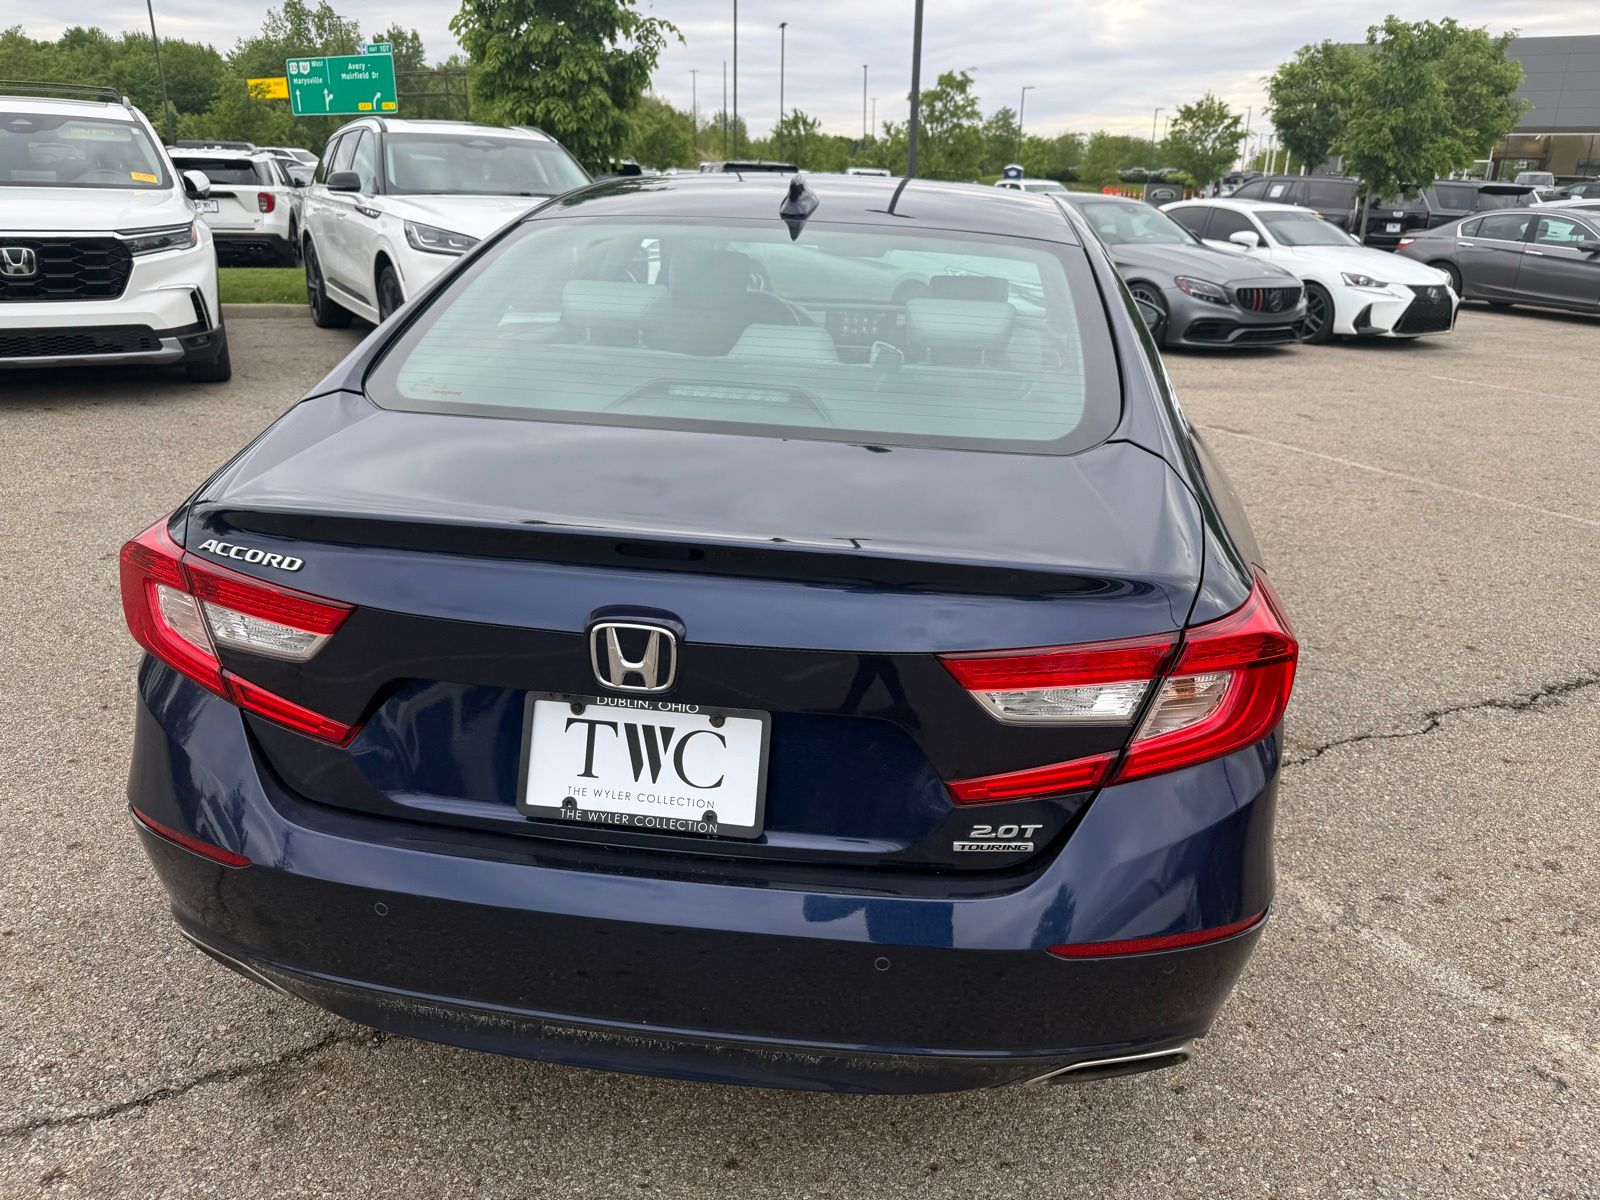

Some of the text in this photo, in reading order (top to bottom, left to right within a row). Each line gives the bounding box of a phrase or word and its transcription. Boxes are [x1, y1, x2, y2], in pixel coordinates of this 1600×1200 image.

[347, 63, 366, 71] Avery
[293, 77, 323, 85] Marysville
[341, 71, 379, 80] Muirfield Dr
[198, 539, 304, 571] ACCORD
[658, 702, 699, 714] OHIO
[564, 717, 727, 789] TWC
[567, 786, 715, 809] THE WYLER COLLECTION
[560, 808, 718, 833] THE WYLER COLLECTION
[969, 824, 1043, 838] 2.0T
[958, 843, 1029, 851] TOURING
